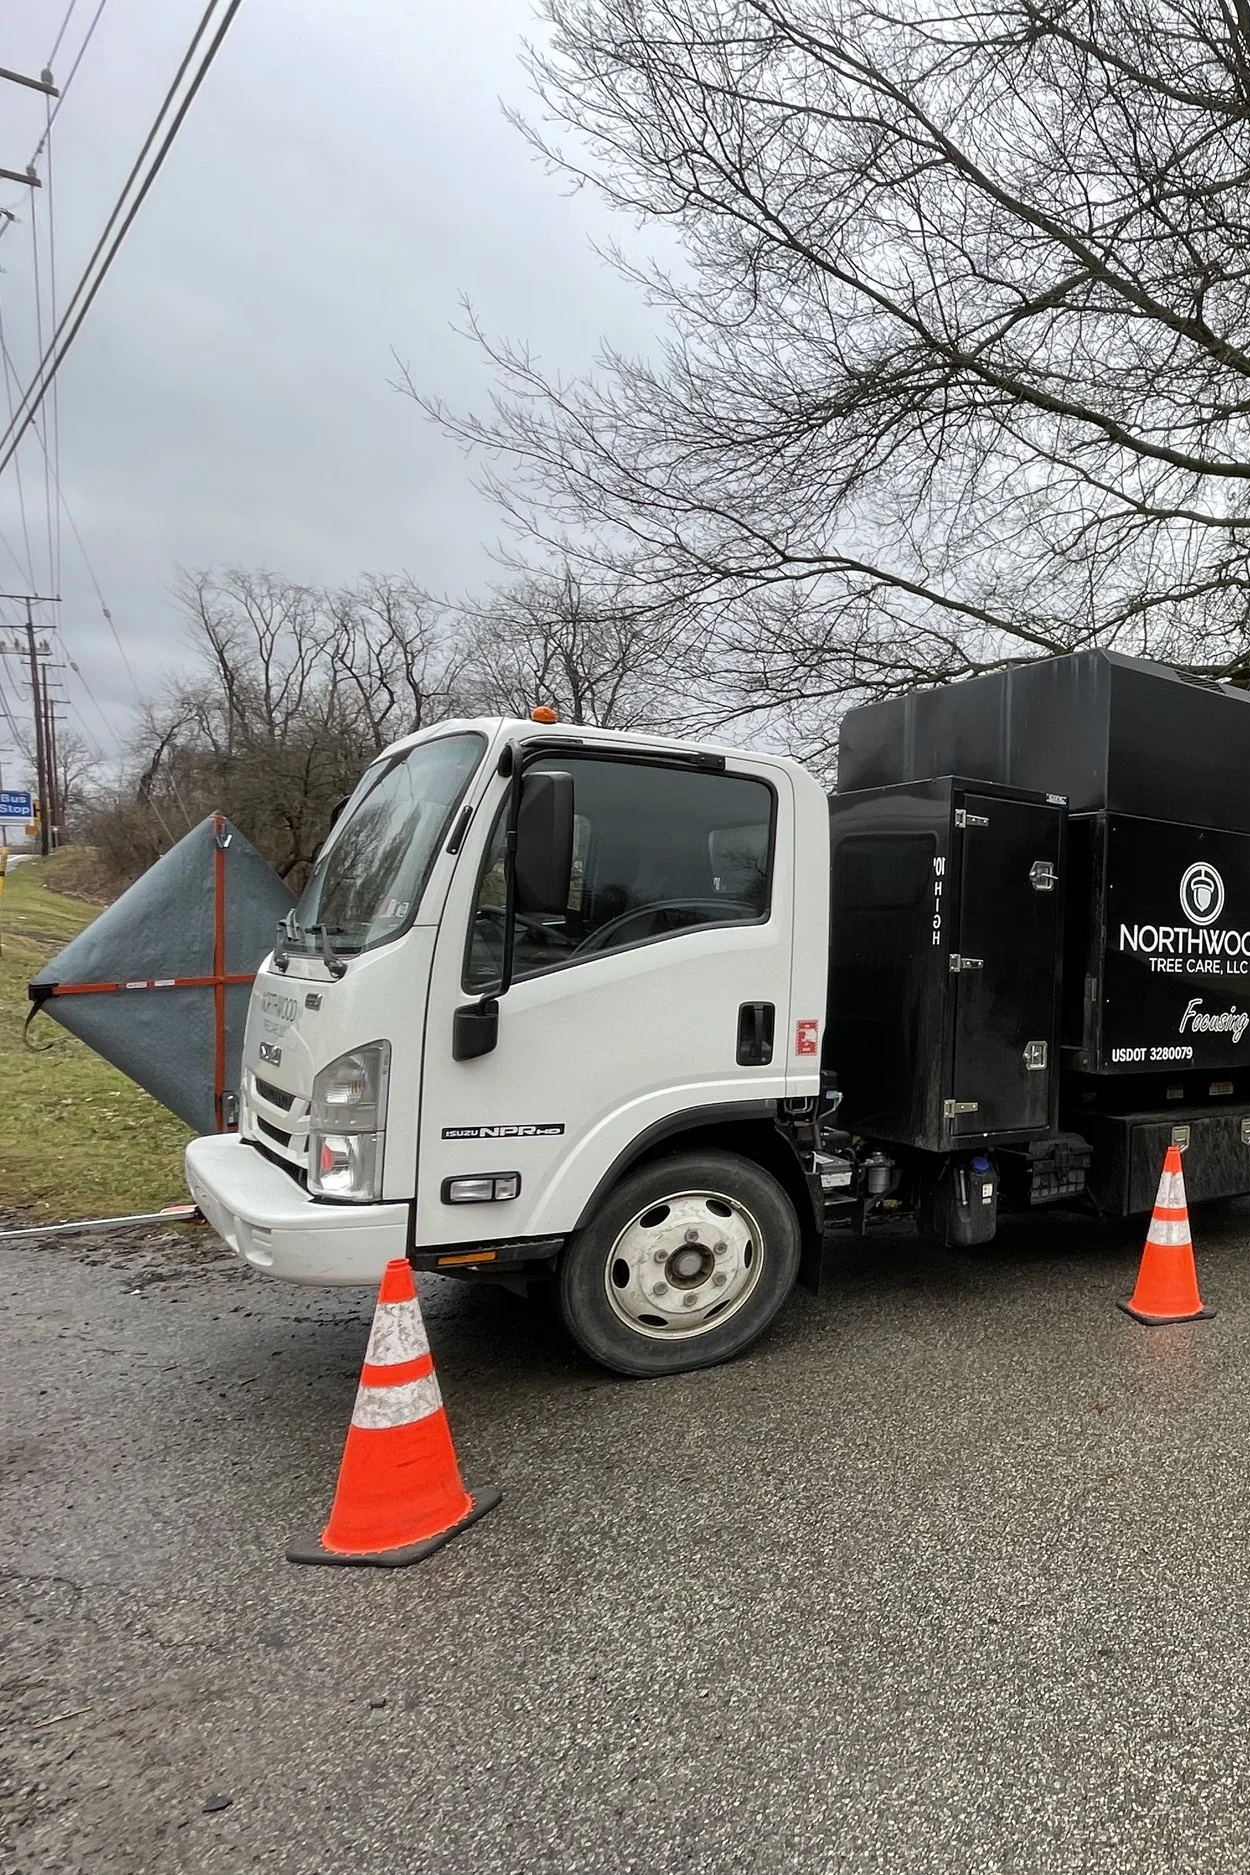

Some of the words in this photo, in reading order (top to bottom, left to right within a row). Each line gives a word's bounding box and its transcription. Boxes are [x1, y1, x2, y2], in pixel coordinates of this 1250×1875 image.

[0, 793, 27, 804] Bus
[0, 804, 30, 815] Stop
[1149, 957, 1183, 973] TREE
[1186, 959, 1223, 975] CARE,
[1226, 960, 1249, 974] LLC
[1179, 998, 1250, 1043] Focusing
[1112, 1047, 1147, 1062] USDOT
[1149, 1046, 1193, 1061] 3280079
[445, 1129, 479, 1138] ISUZU
[479, 1125, 537, 1138] NPR
[536, 1127, 561, 1135] HD
